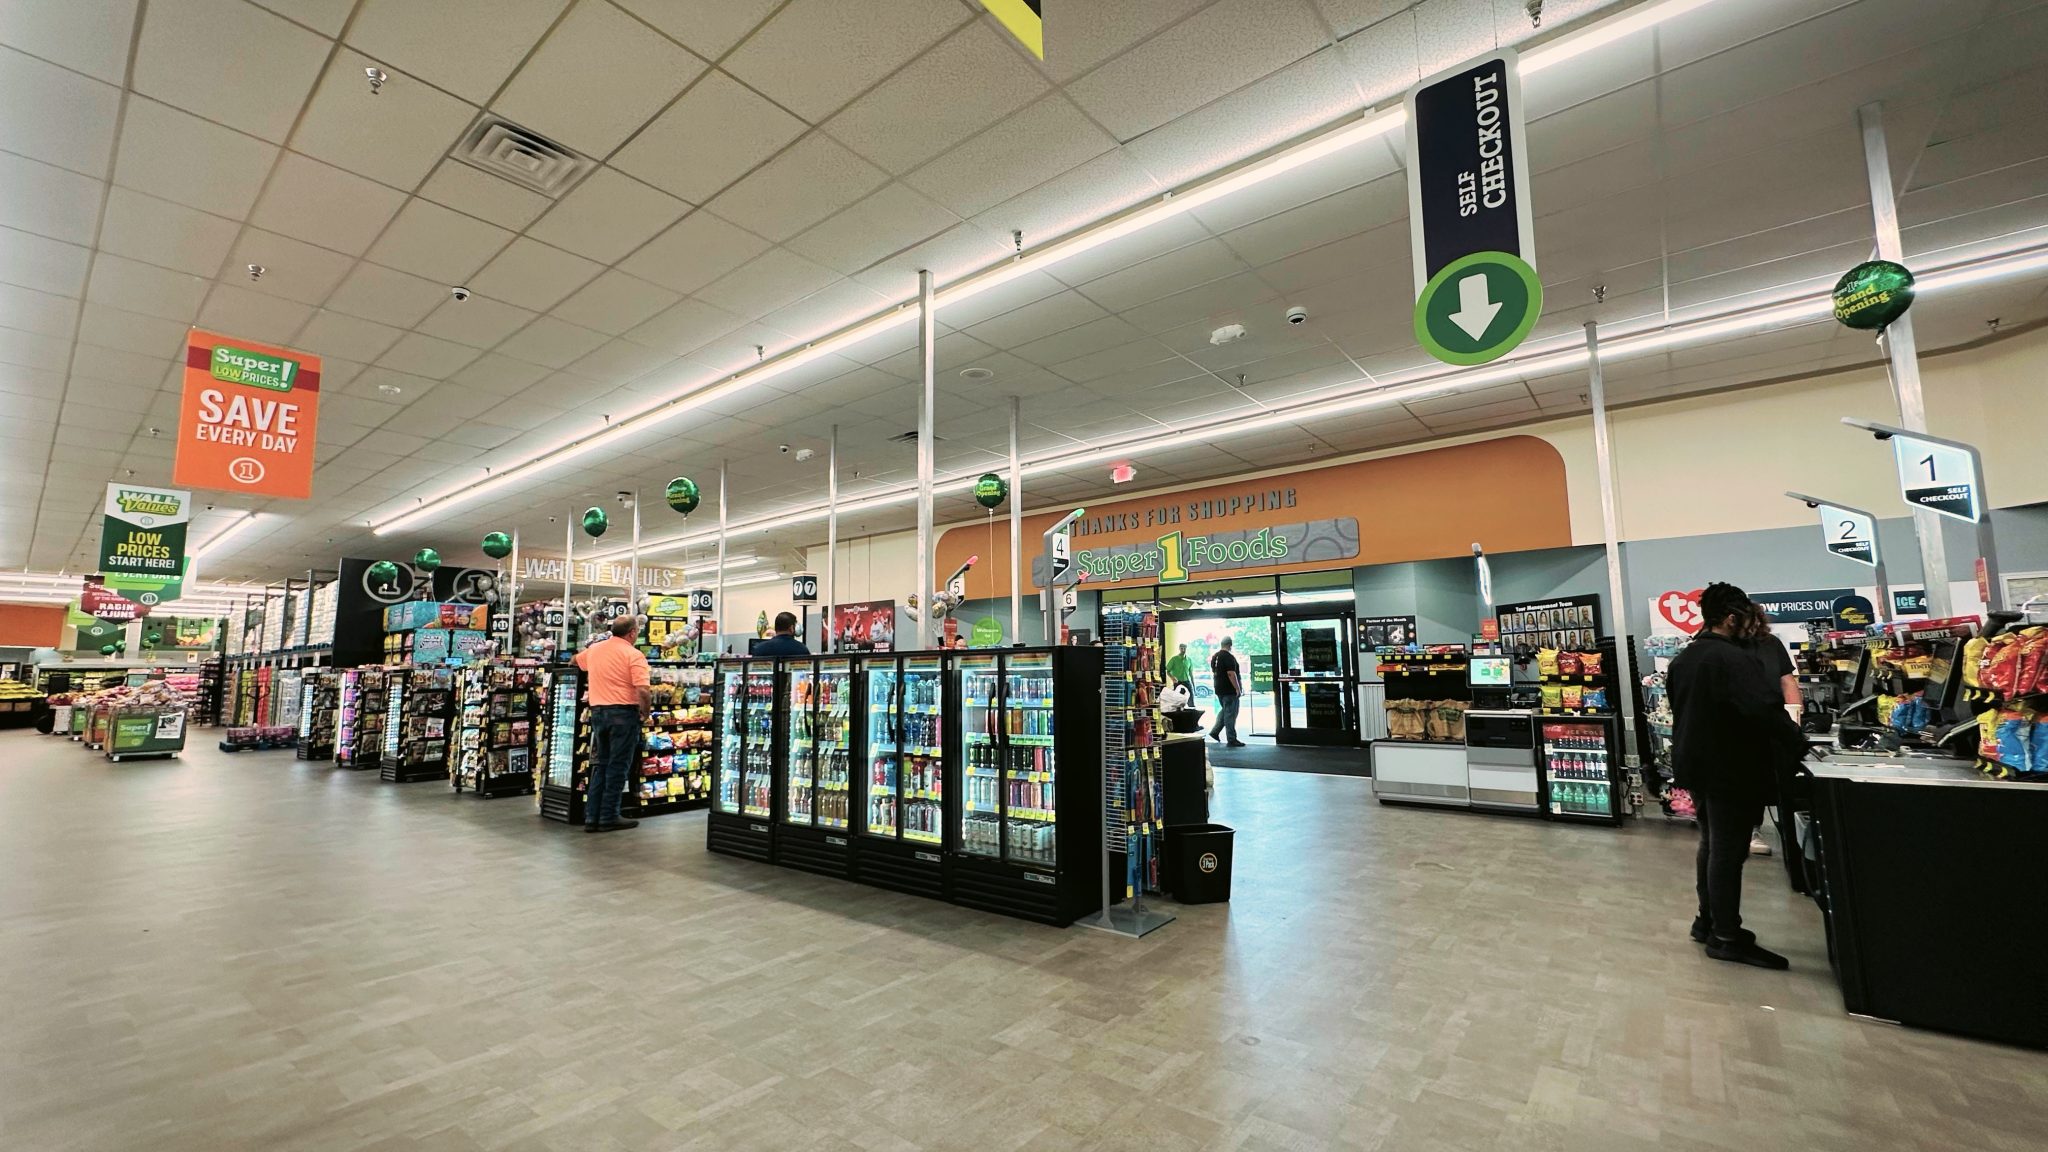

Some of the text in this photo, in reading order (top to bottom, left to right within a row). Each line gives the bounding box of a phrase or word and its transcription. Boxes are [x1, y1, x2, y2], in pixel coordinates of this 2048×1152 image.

[1474, 72, 1507, 209] CHECKOUT
[1458, 170, 1477, 217] SELF
[1836, 283, 1875, 308] Grand
[1835, 291, 1890, 319] Opening
[216, 365, 279, 388] LOW PRICES
[198, 389, 299, 436] SAVE
[196, 423, 298, 454] EVERY DAY
[1919, 454, 1936, 482] 1
[121, 491, 179, 505] WALL
[1919, 492, 1969, 503] CHECKOUT
[1946, 486, 1969, 495] SELF
[117, 498, 178, 515] Values
[1070, 487, 1297, 537] THANKS FOR SHOPPING
[1839, 520, 1857, 540] 2
[128, 531, 162, 546] LOW
[116, 543, 170, 559] PRICES
[1056, 538, 1064, 556] 4
[1077, 526, 1289, 584] Super 1 Foods
[1838, 545, 1870, 553] CHECKOUT
[108, 555, 176, 569] START HERE!
[525, 557, 576, 581] WALL
[610, 564, 672, 588] VALUES
[807, 582, 814, 594] 7
[953, 581, 960, 595] 5
[702, 595, 710, 605] 8
[1065, 593, 1072, 605] 6
[1781, 602, 1814, 612] PRICES
[1814, 600, 1829, 611] ON
[1896, 597, 1916, 607] ICE
[93, 610, 136, 618] CAJUNS
[1663, 594, 1704, 625] ty
[1912, 629, 1951, 640] HERSHEY'S
